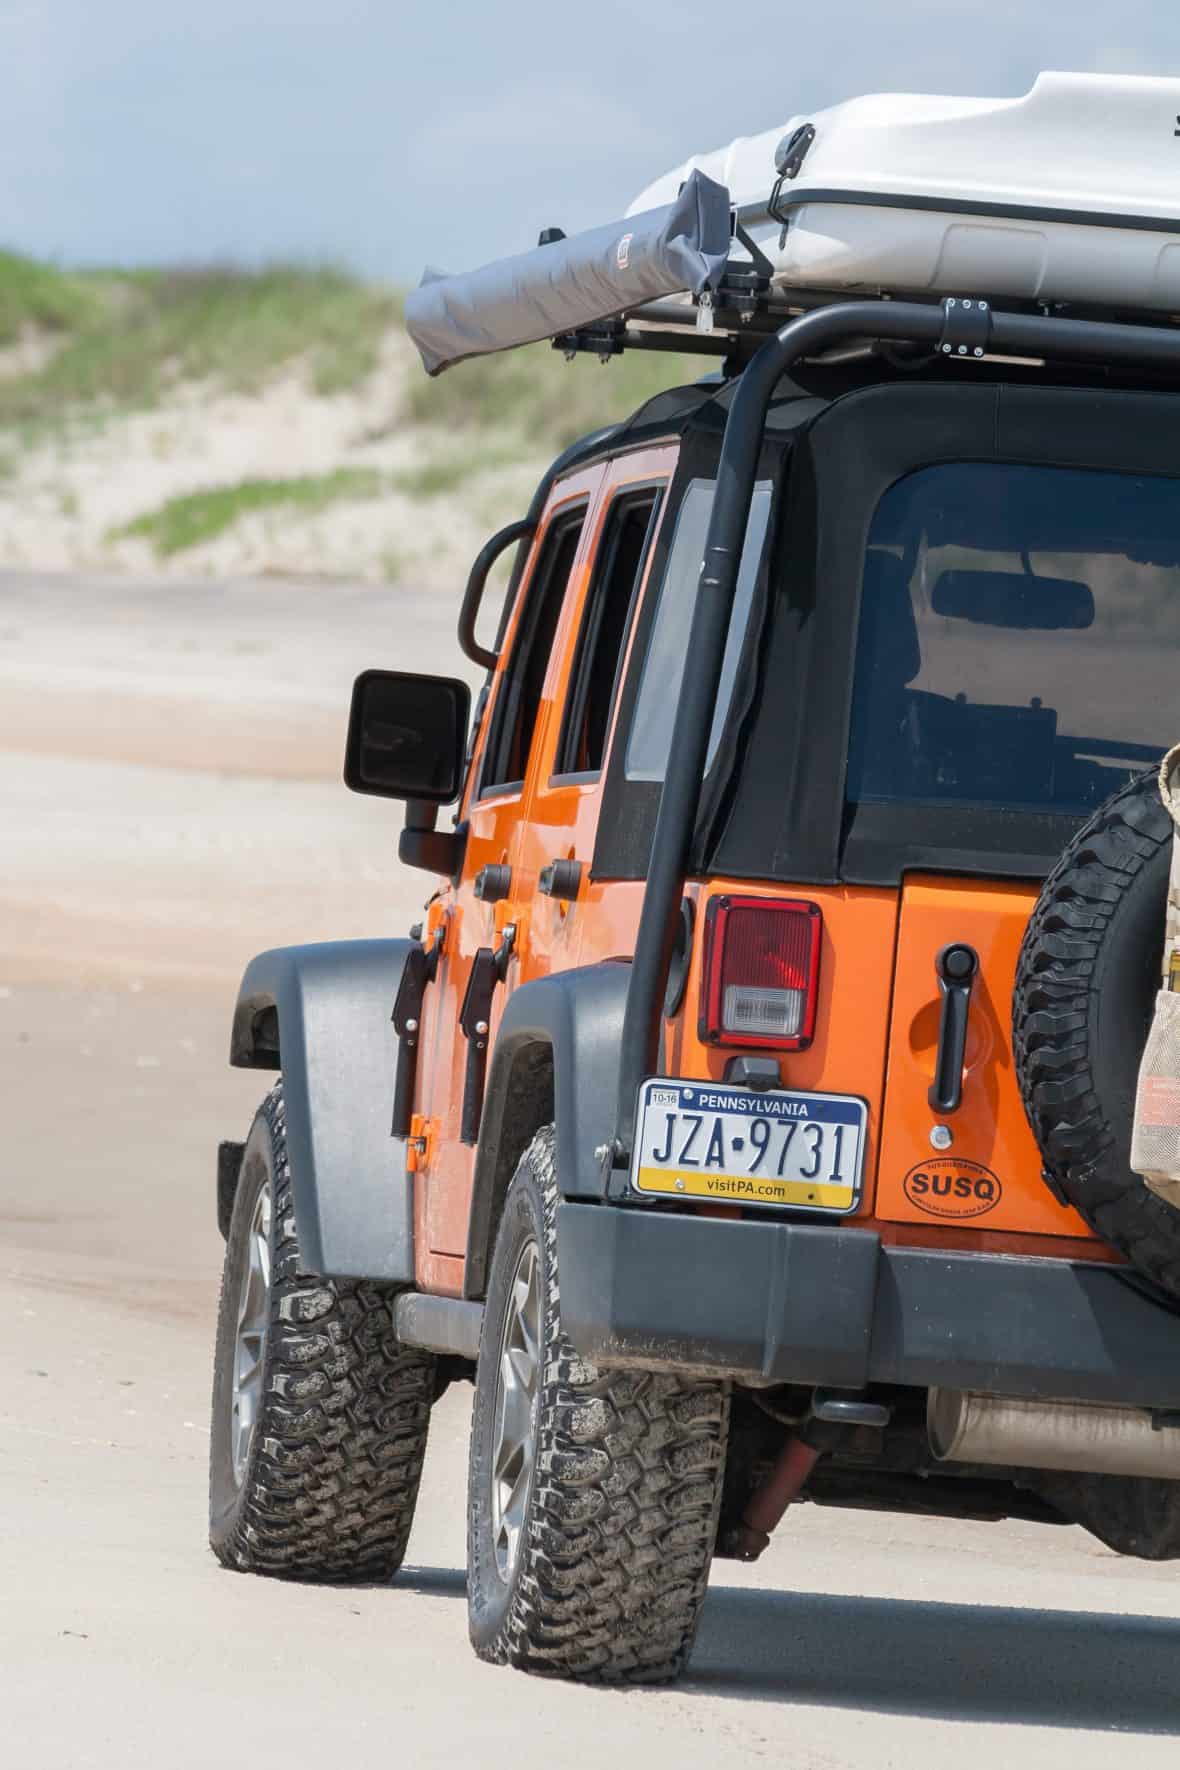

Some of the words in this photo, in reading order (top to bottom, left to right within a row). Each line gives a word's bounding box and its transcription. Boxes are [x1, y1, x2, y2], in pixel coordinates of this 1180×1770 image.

[653, 1094, 677, 1104] 10-16
[699, 1094, 809, 1117] PENNSYLVANIA
[707, 1179, 785, 1197] visitPA.com
[911, 1173, 995, 1202] SUSQ
